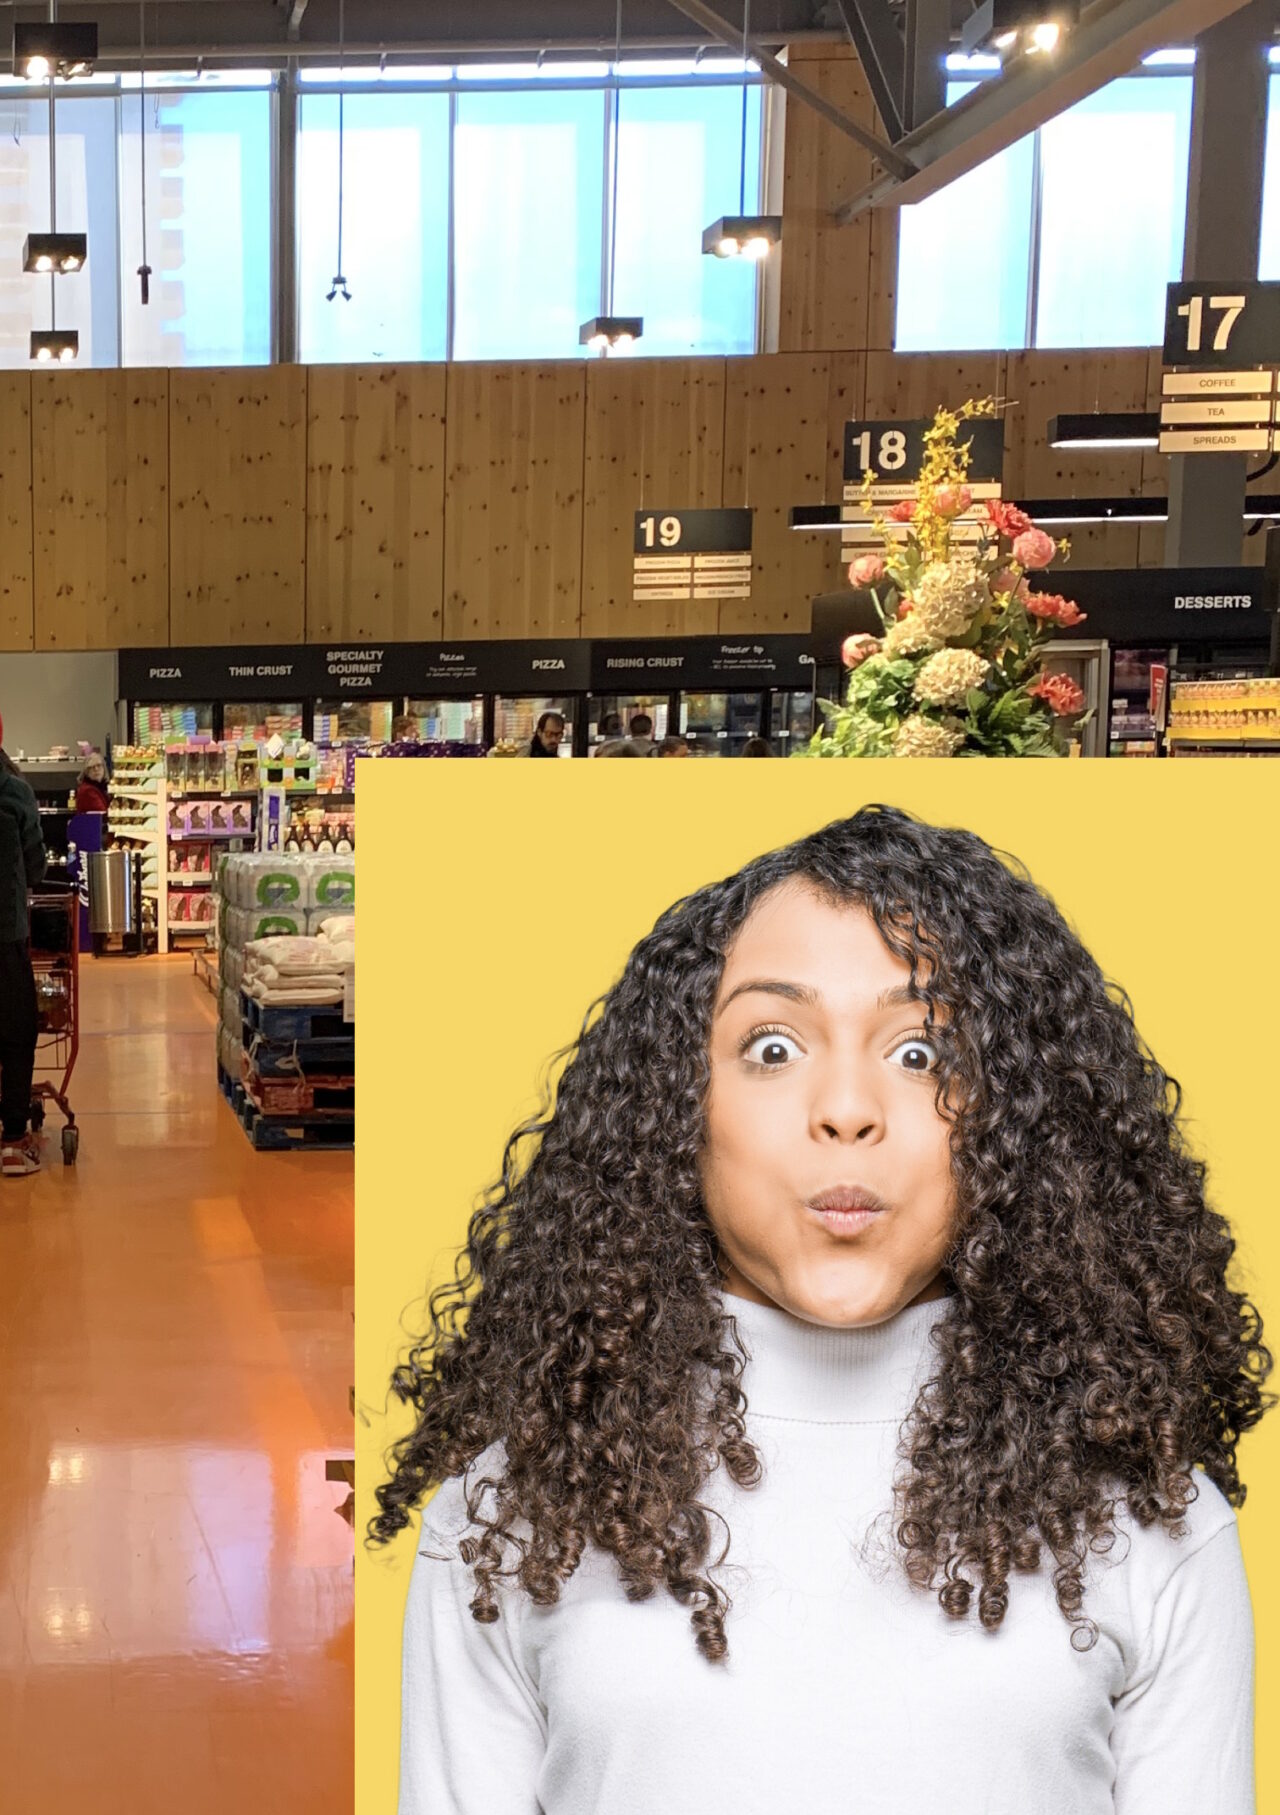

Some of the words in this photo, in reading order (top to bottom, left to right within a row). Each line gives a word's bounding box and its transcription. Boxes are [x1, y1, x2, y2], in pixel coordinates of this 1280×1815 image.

[1178, 296, 1246, 350] 17
[1199, 379, 1236, 388] COFFEE
[1207, 408, 1225, 416] TEA
[1193, 436, 1237, 445] SPREADS
[852, 430, 907, 470] 18
[640, 516, 681, 547] 19
[1174, 595, 1252, 609] DESSERTS
[326, 650, 384, 662] SPECIALTY
[532, 659, 566, 670] PIZZA
[606, 658, 645, 669] RISING
[647, 656, 685, 668] CRUST
[149, 668, 182, 678] PIZZA
[229, 666, 254, 677] THIN
[256, 665, 293, 676] CRUST
[327, 663, 383, 675] GOURMET
[339, 676, 372, 687] PIZZA
